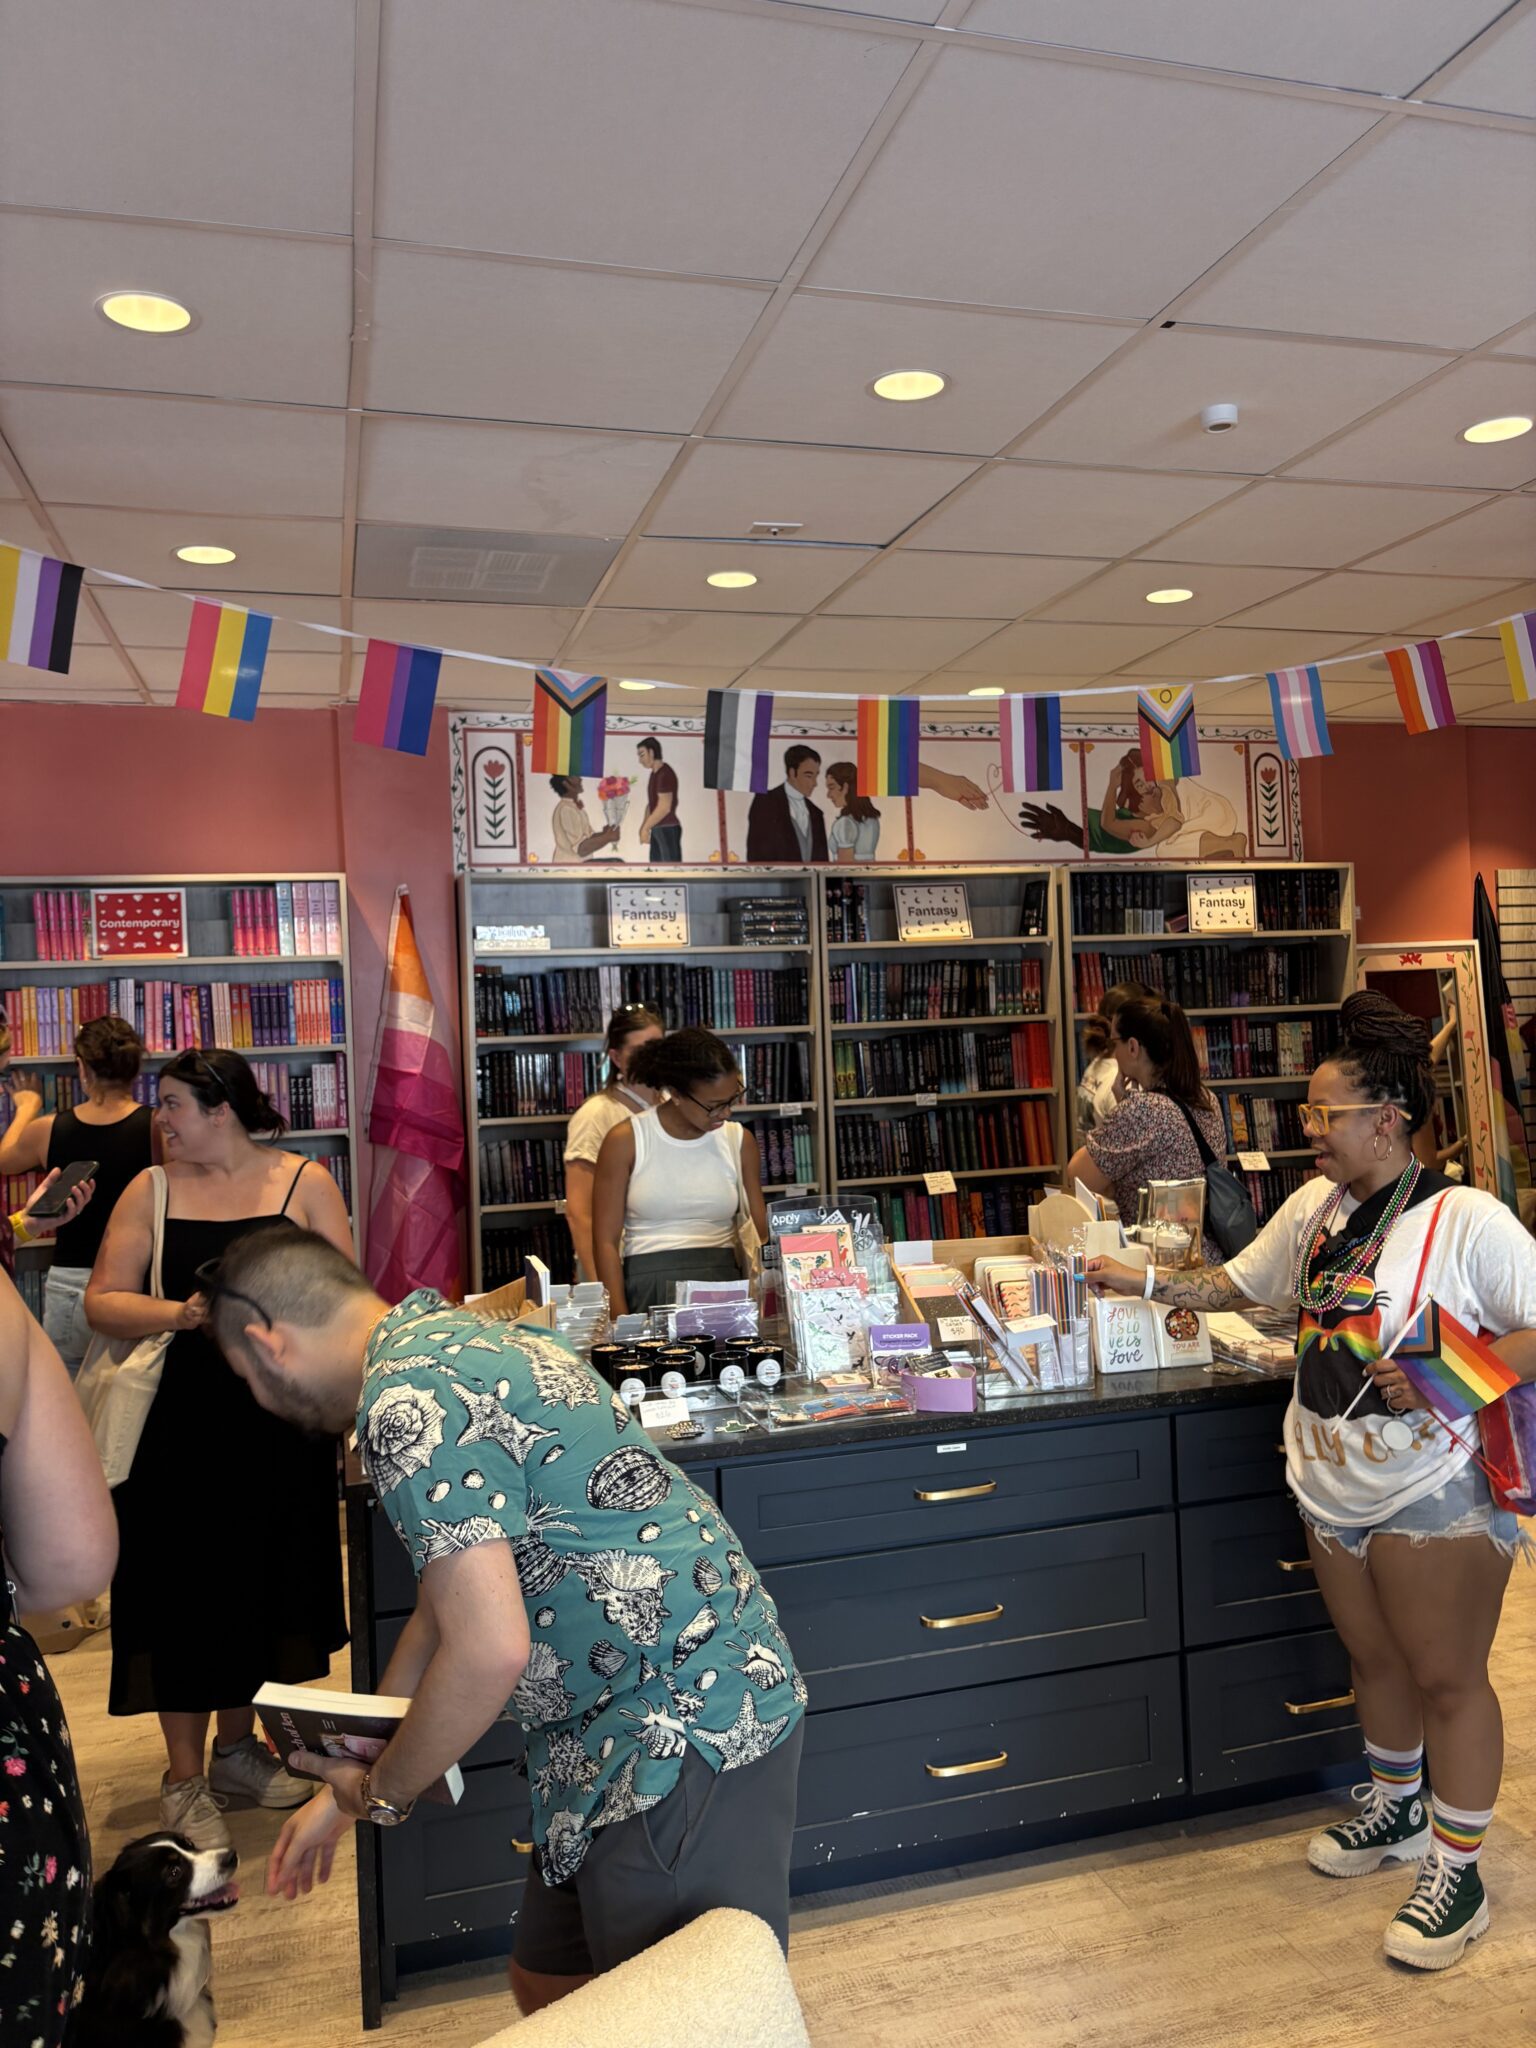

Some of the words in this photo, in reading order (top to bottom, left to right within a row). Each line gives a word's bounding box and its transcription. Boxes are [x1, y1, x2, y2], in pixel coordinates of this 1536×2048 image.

[1199, 897, 1246, 909] Fantasy
[621, 909, 677, 922] Fantasy
[907, 906, 958, 917] Fantasy
[99, 919, 180, 929] Contemporary
[1107, 1306, 1140, 1323] LOVE
[1172, 1342, 1187, 1350] YOU
[1187, 1341, 1201, 1349] ARE
